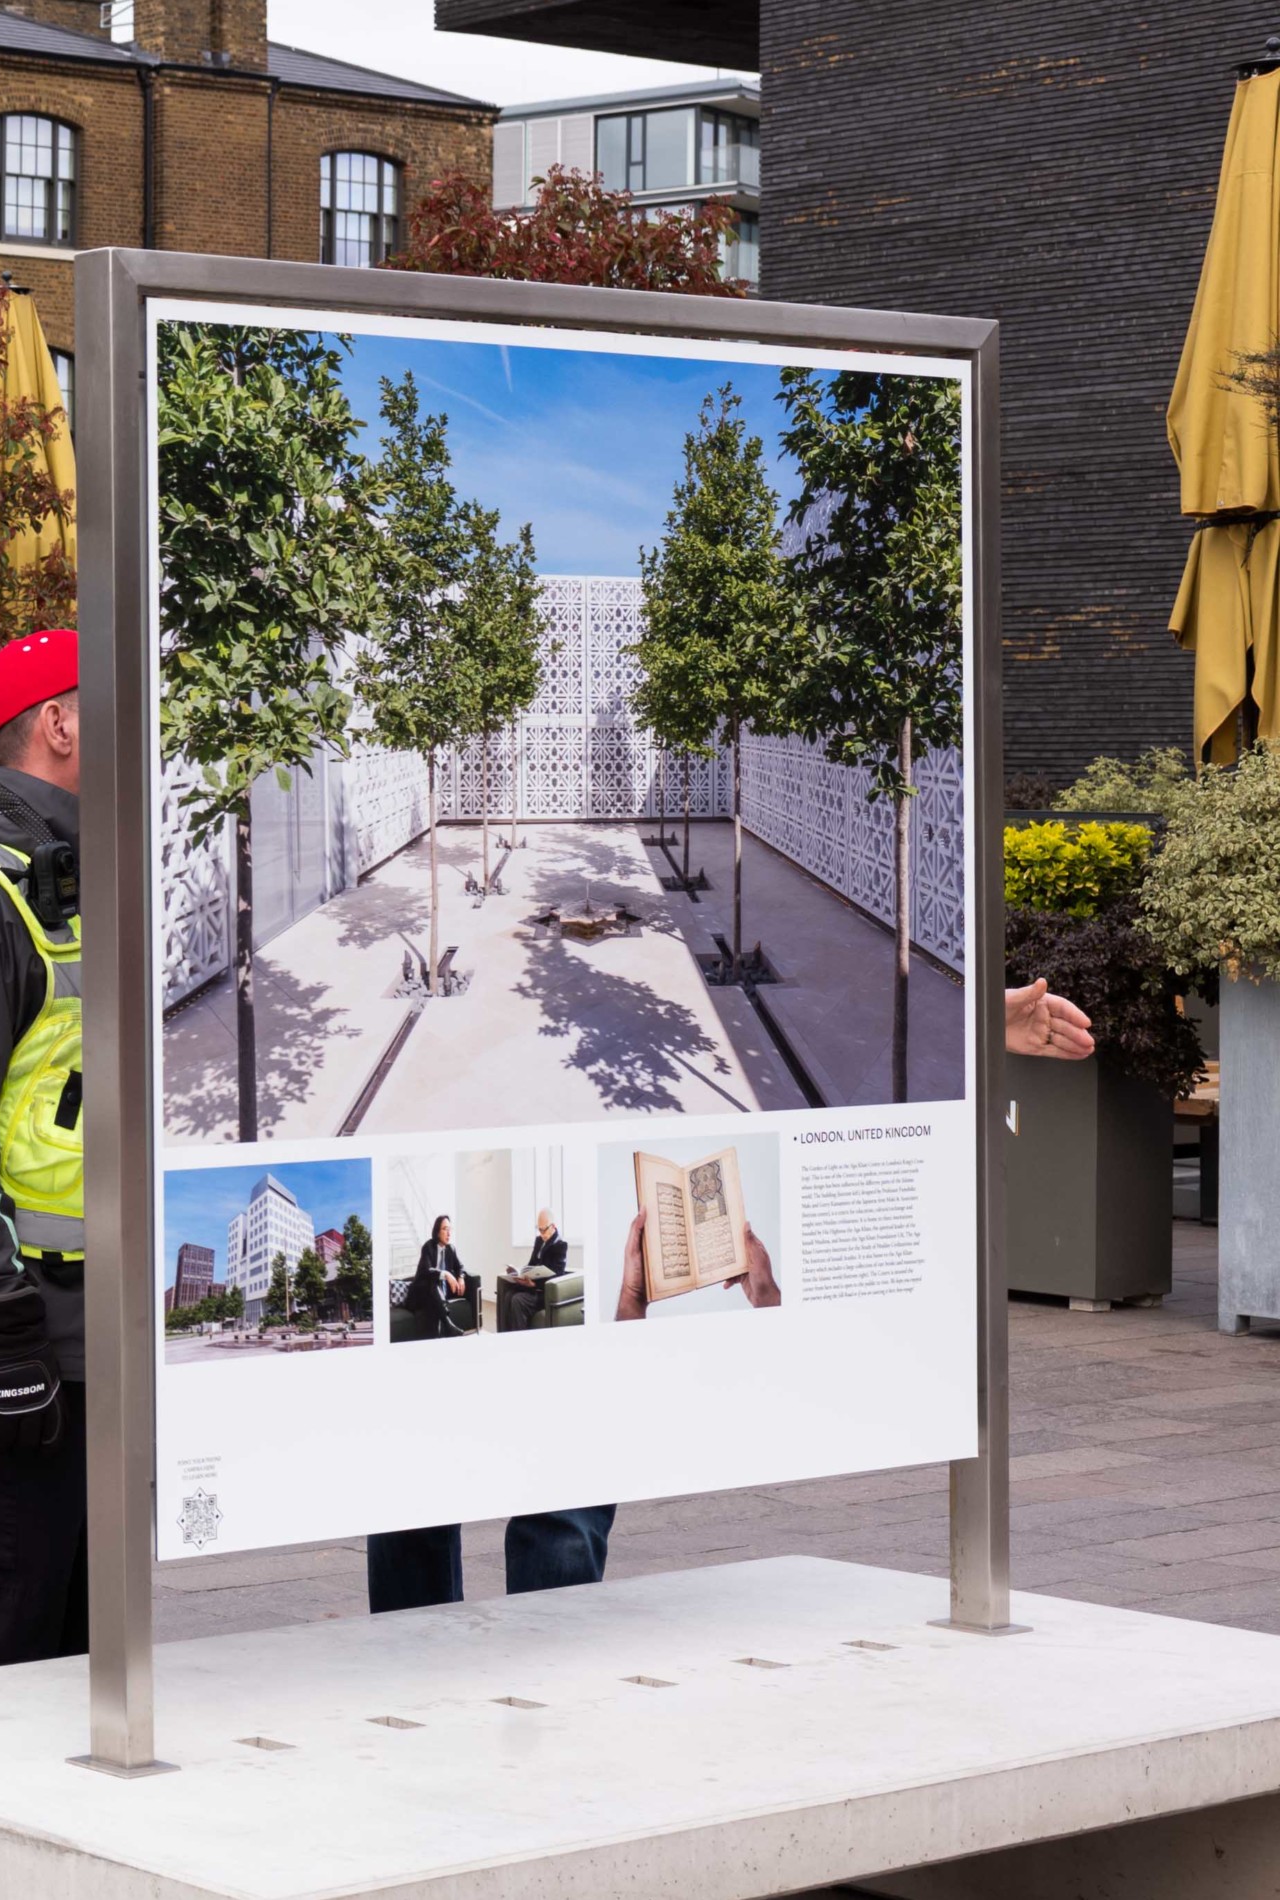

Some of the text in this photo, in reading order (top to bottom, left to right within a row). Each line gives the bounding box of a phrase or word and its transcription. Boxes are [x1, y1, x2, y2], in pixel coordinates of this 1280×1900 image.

[800, 1125, 932, 1144] LONDON, UNITED KINGDOM
